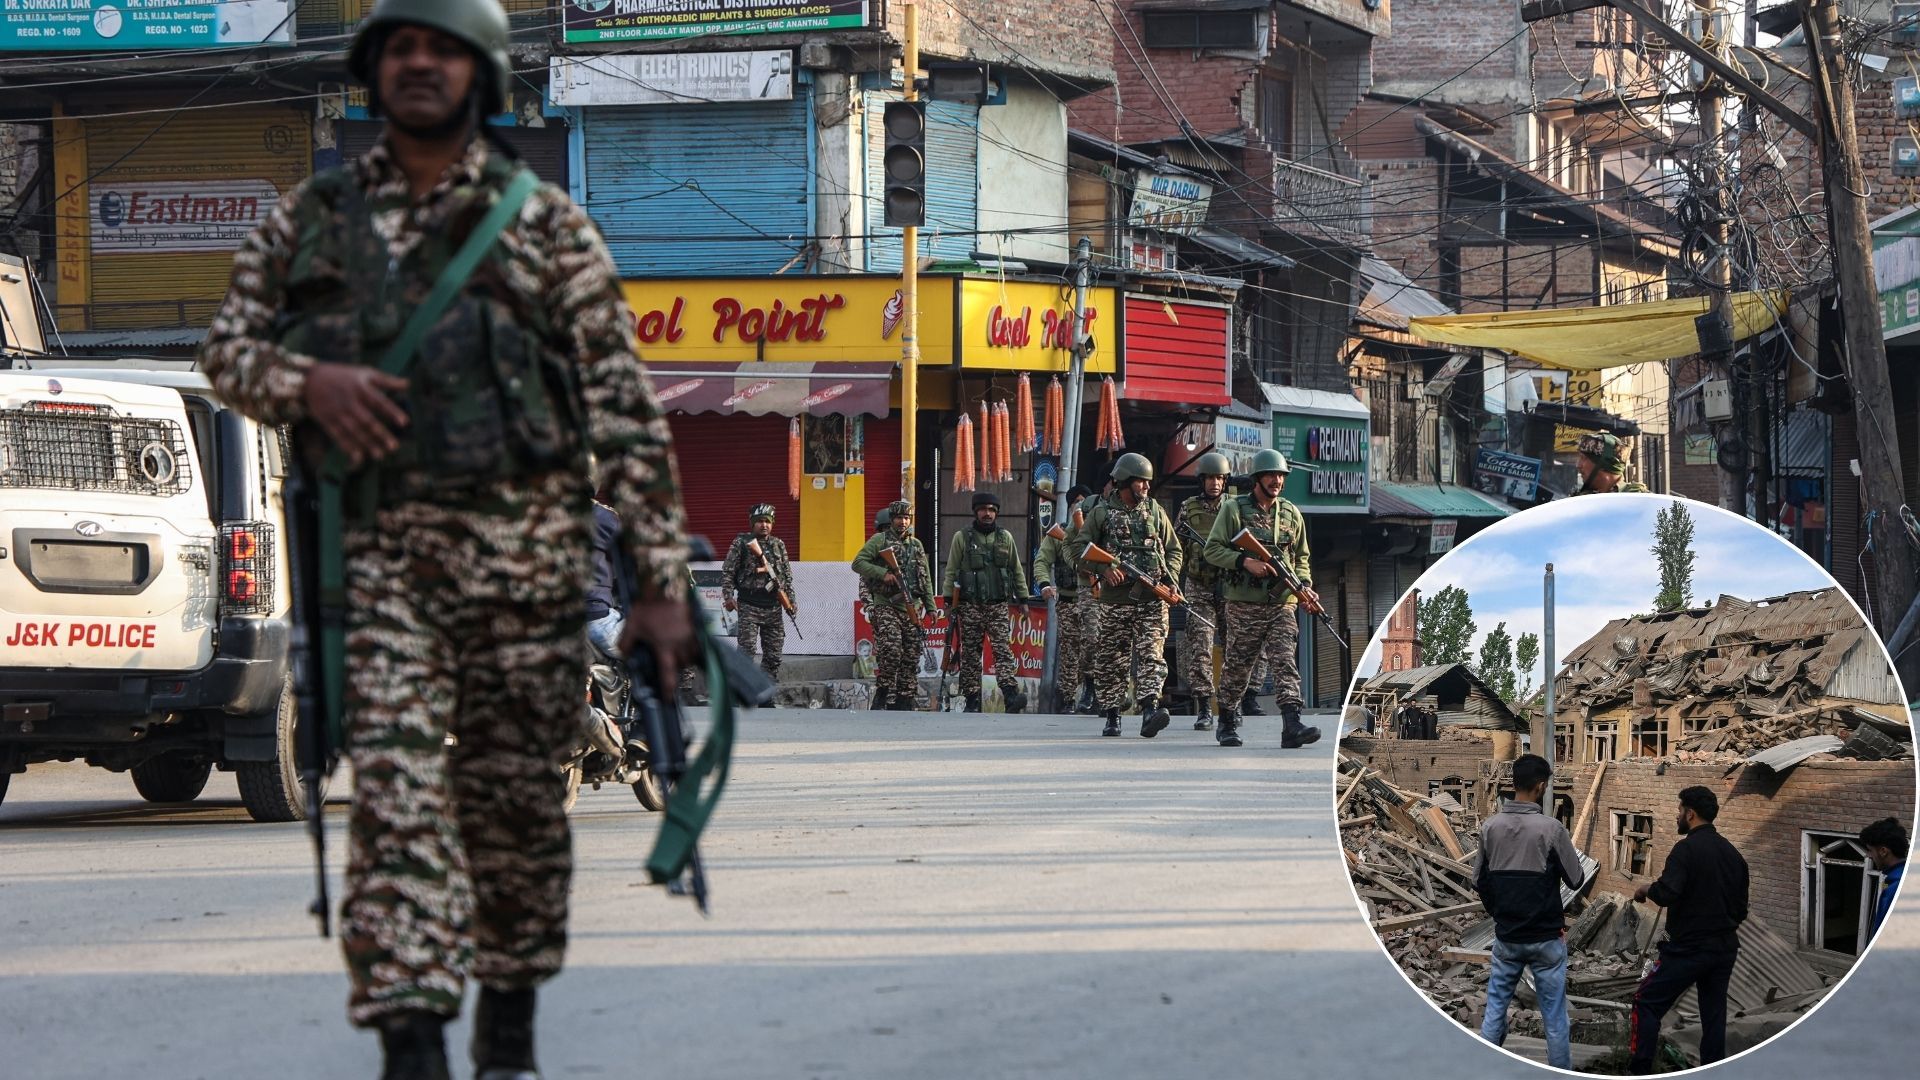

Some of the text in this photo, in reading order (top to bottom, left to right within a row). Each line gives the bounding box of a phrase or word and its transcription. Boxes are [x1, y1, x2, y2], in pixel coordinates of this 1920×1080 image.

[636, 13, 698, 25] ORTHOPAEDIC
[700, 10, 743, 21] IMPLANTS
[754, 8, 798, 18] SURGICAL
[723, 0, 809, 9] DISTRI
[17, 28, 42, 37] REGD.
[44, 28, 56, 37] NO
[62, 28, 81, 36] 1609
[145, 25, 169, 34] REGD.
[170, 25, 182, 34] NO
[190, 25, 208, 34] 1023
[599, 31, 615, 39] 2ND
[616, 29, 641, 38] FLOOR
[642, 27, 678, 36] JANGLAT
[679, 25, 704, 34] MANDI
[767, 20, 785, 29] GMC
[786, 18, 829, 28] ANANTNAG
[641, 54, 749, 81] ELECTRONICS
[1150, 177, 1201, 202] MIR DABHA
[127, 191, 259, 225] Eastman
[62, 174, 79, 282] Eastman
[627, 292, 846, 344] ol Point
[988, 305, 1097, 350] Cool Poit
[1226, 423, 1239, 443] MIR
[1240, 427, 1262, 447] DABHA
[1320, 427, 1360, 462] REHMANI
[1312, 471, 1338, 494] MEDICAL
[1478, 463, 1536, 479] BEAUTY SALOON
[7, 623, 156, 648] J&K POLICE
[1017, 613, 1046, 647] Poi
[1021, 651, 1042, 669] Corn
